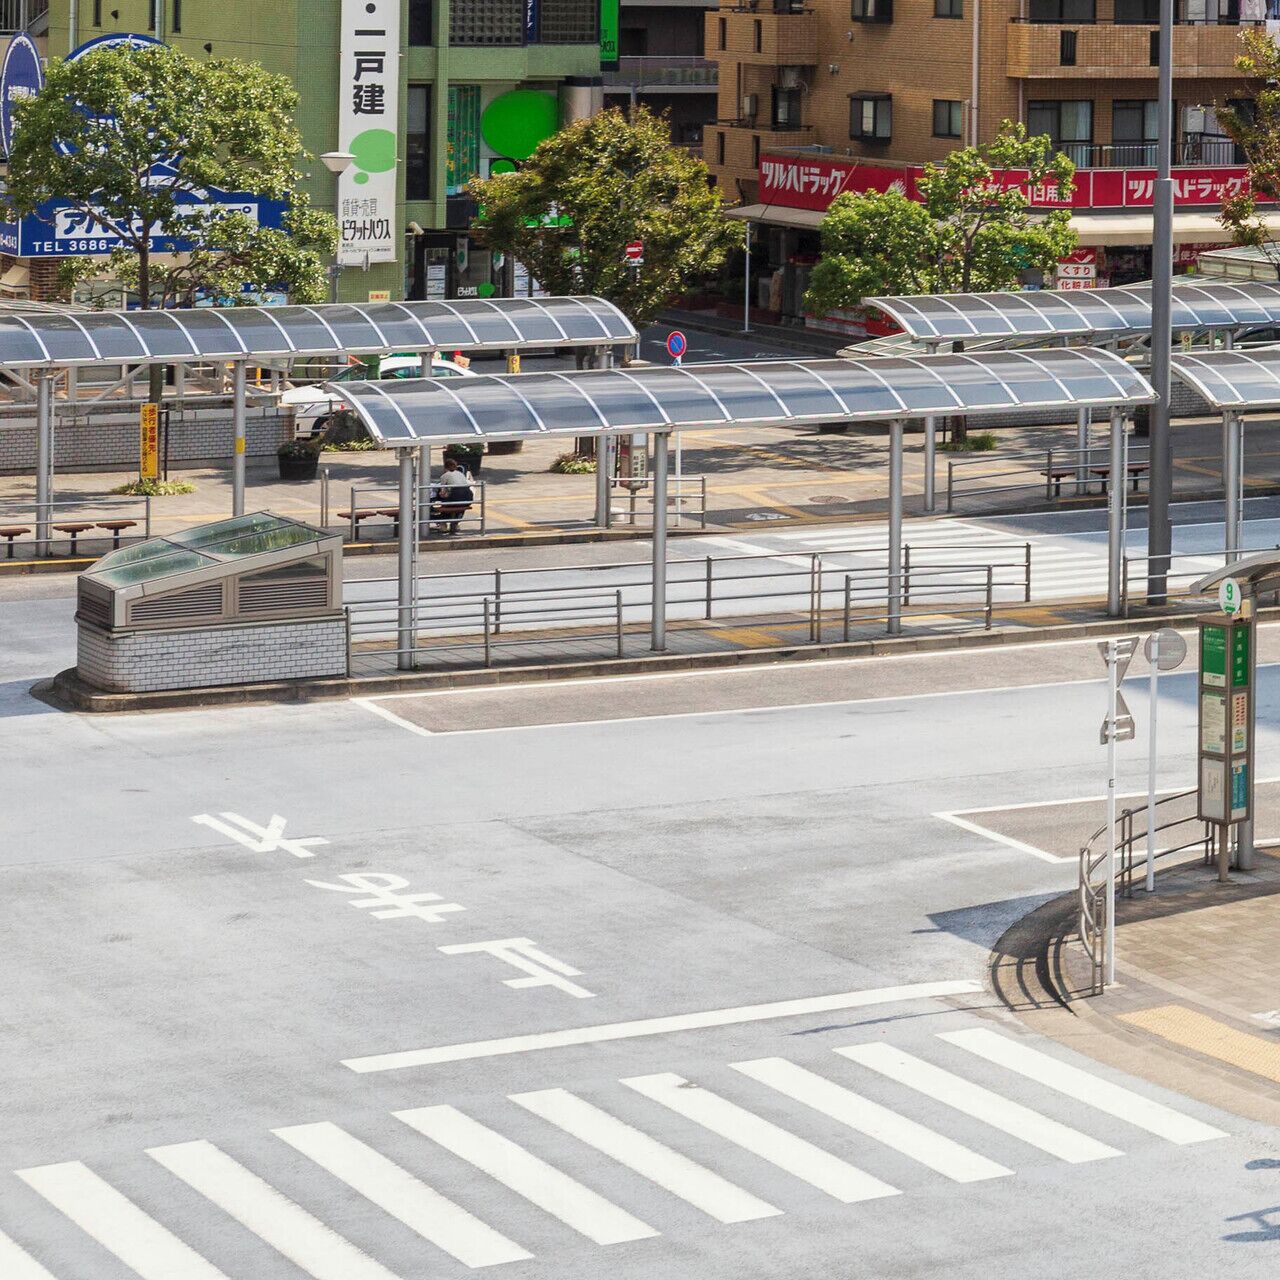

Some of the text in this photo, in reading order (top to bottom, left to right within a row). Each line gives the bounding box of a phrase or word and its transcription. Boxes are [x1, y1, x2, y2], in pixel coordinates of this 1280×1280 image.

[762, 162, 846, 197] ツルハドラッグ
[342, 198, 377, 217] 賃貸・売買
[342, 219, 391, 241] ピタットハウス
[33, 239, 154, 253] TEL 3686-43
[1062, 265, 1091, 275] くすり
[1061, 279, 1092, 289] 化粧品
[1226, 583, 1234, 600] 9
